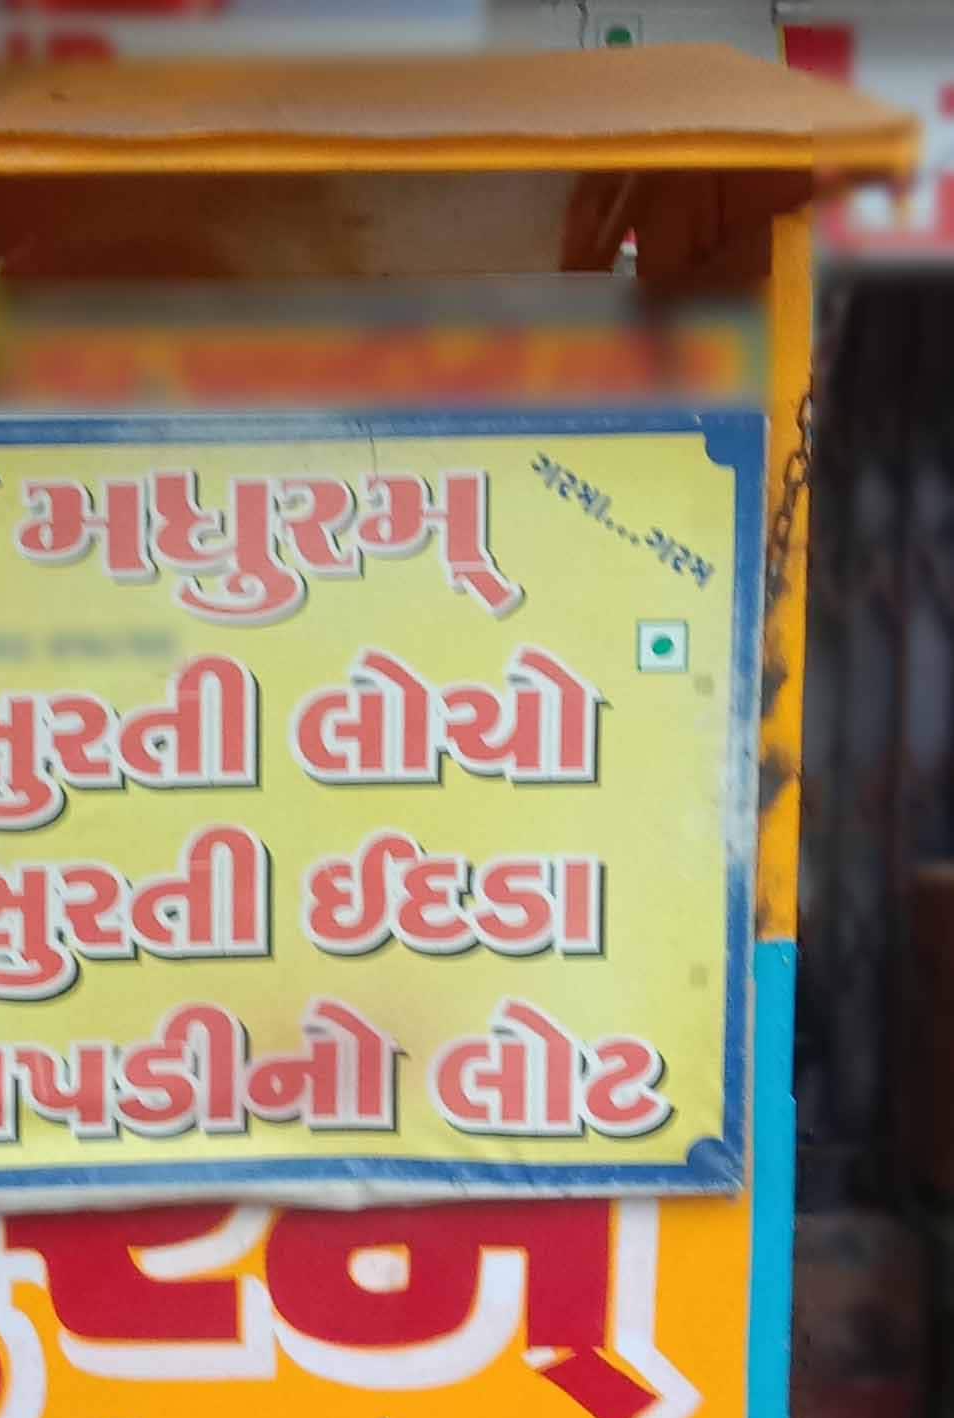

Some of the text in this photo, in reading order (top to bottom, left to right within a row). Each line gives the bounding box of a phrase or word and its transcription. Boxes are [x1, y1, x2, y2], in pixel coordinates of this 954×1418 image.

[16, 472, 520, 618] મધુરમ્
[294, 649, 594, 780] લોચો
[304, 832, 598, 953] ઈદડા
[431, 1001, 668, 1134] લોટ
